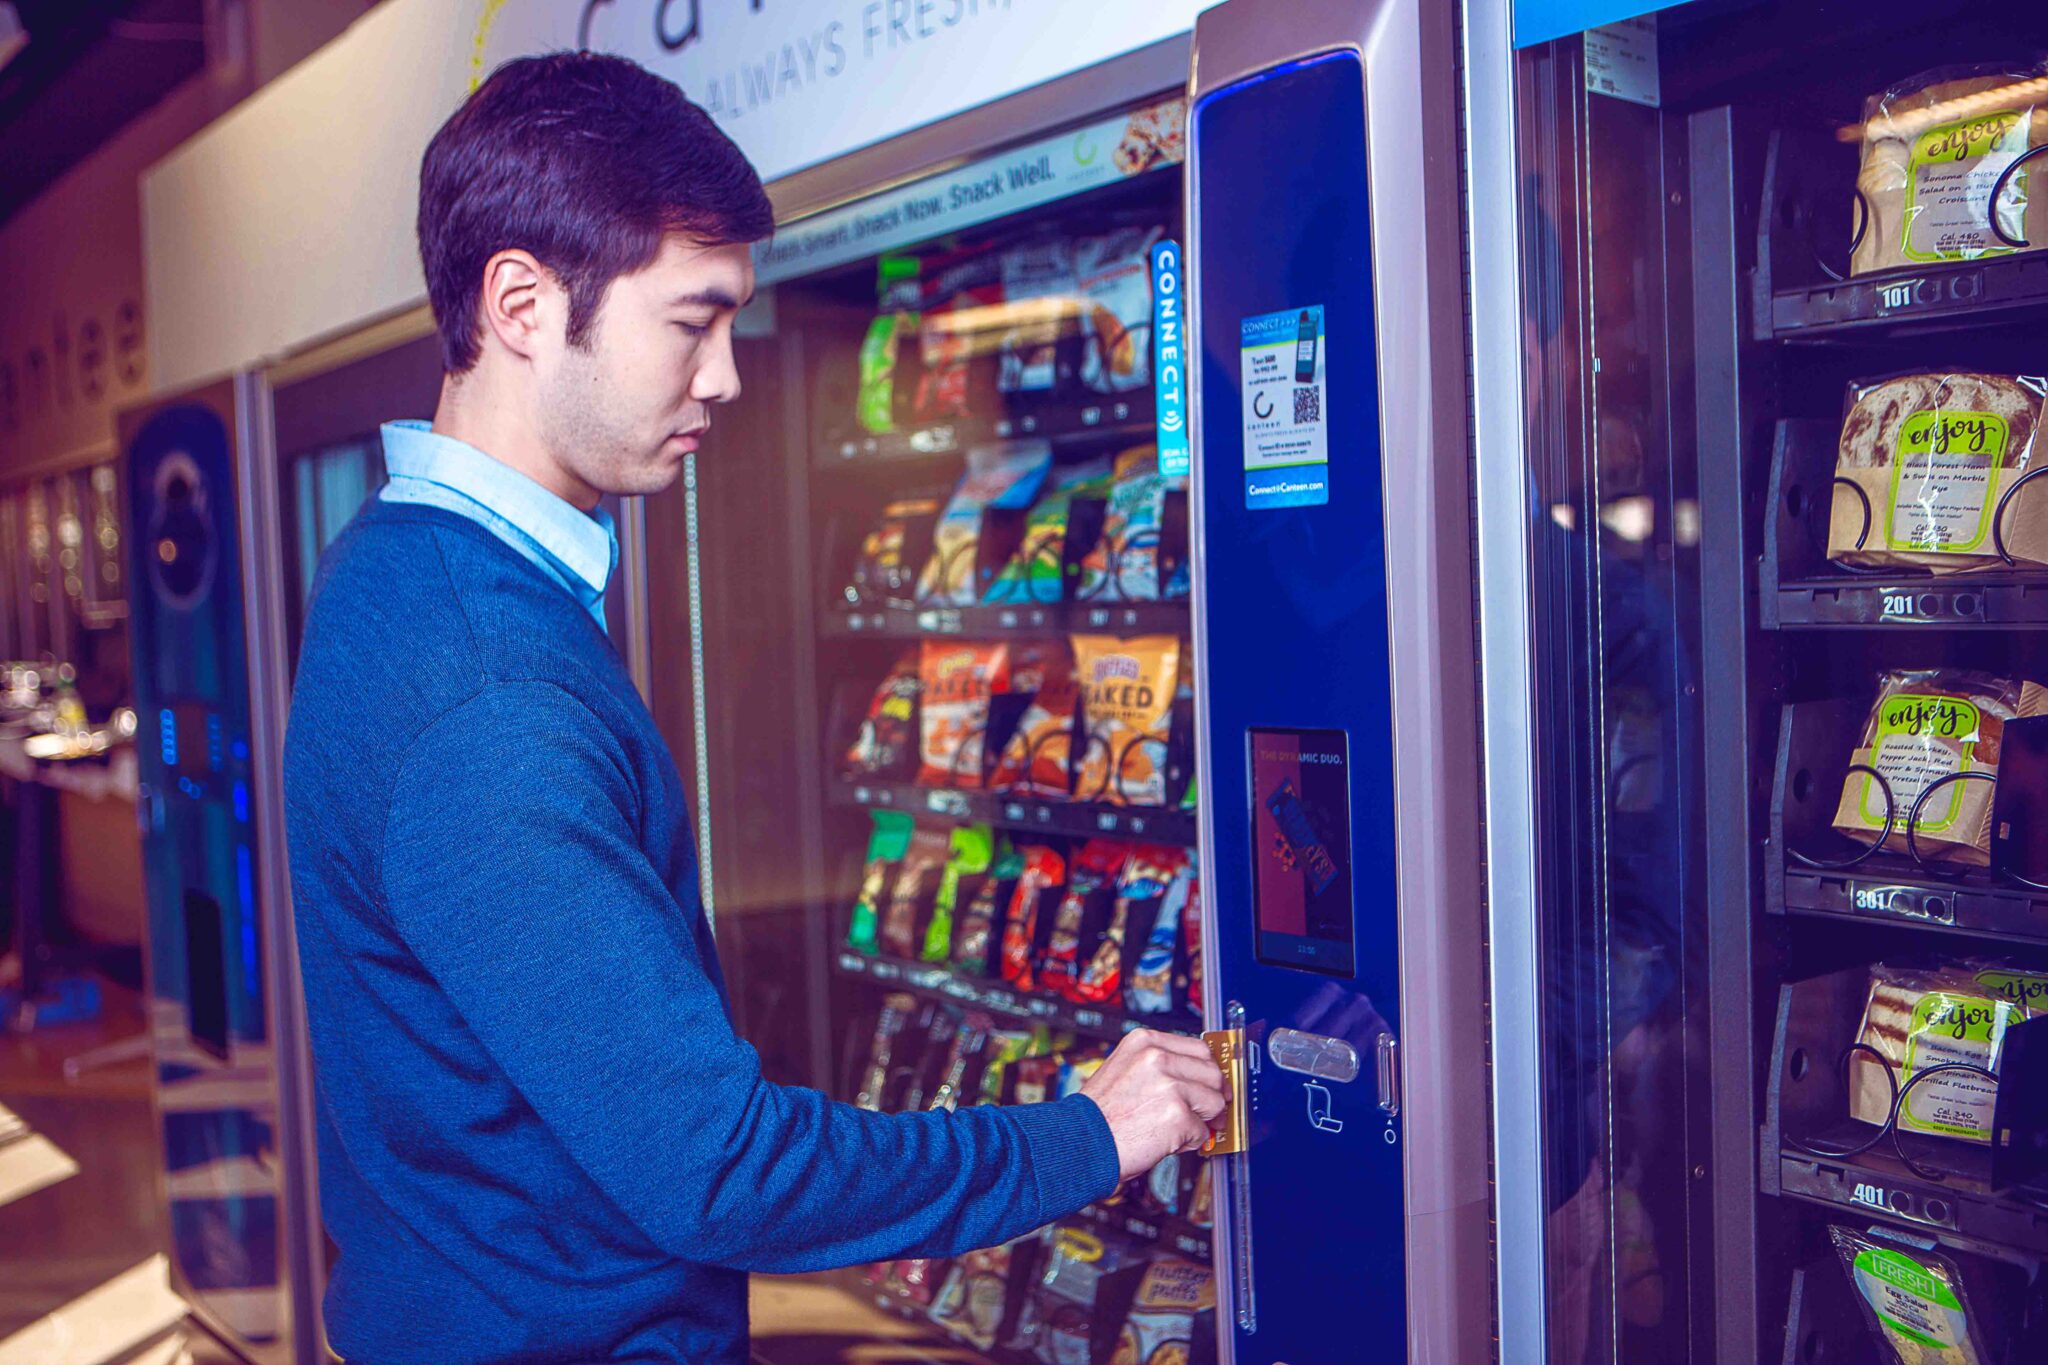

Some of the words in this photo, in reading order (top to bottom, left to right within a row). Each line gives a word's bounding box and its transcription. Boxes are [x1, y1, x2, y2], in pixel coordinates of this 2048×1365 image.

[704, 20, 847, 119] ALWAYS
[1927, 117, 2016, 161] enjoy
[1923, 173, 1963, 183] Sonoma
[854, 211, 903, 239] Snack
[903, 198, 946, 222] Now.
[948, 178, 1005, 210] Snack
[1007, 156, 1056, 191] Well.
[1919, 185, 1945, 196] Salad
[1938, 194, 1987, 205] Croissant
[1941, 233, 1956, 241] Cal.
[1960, 232, 1980, 240] 480
[1882, 286, 1911, 309] 101
[1158, 250, 1179, 405] CONNECT
[1242, 317, 1280, 335] CONNECT
[1908, 416, 1998, 455] enjoy
[1906, 461, 1928, 469] Black
[1931, 461, 1959, 470] Forest
[1962, 461, 1986, 471] Ham
[1952, 473, 1986, 482] Marble
[1883, 595, 1913, 615] 201
[1888, 701, 1969, 736] enjoy
[1884, 743, 1914, 751] Roasted
[1320, 753, 1343, 765] DUO.
[1880, 754, 1906, 762] Pepper
[1934, 758, 1954, 766] Red
[1876, 764, 1903, 773] Pepper
[1891, 775, 1921, 785] Pretzel
[1856, 889, 1886, 911] 301
[1930, 1044, 1963, 1055] Bacon,
[1965, 1050, 1983, 1060] Egg
[1954, 1110, 1973, 1119] 340
[1854, 1182, 1885, 1207] 401
[1878, 1262, 1930, 1293] FRESH
[1885, 1285, 1902, 1300] Egg
[1903, 1294, 1929, 1312] Salad
